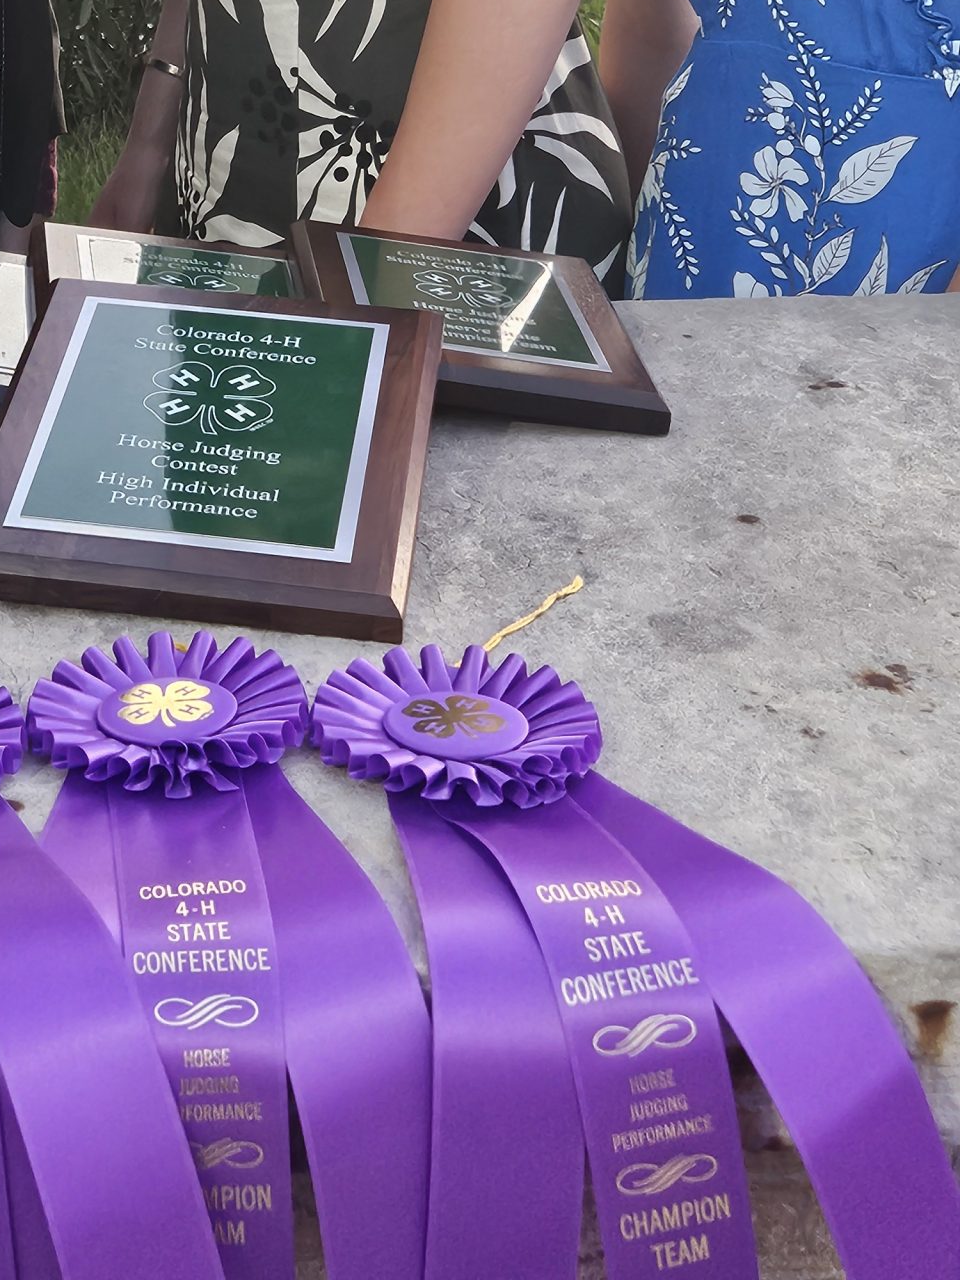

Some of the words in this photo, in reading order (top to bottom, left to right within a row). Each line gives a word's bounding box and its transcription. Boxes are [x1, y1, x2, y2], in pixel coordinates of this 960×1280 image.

[386, 255, 427, 267] State
[431, 261, 524, 280] Conference
[396, 250, 472, 266] Colorado
[160, 274, 182, 284] H
[204, 280, 226, 288] H
[168, 262, 260, 279] Conference
[425, 273, 448, 283] H
[470, 279, 492, 288] H
[429, 287, 451, 296] H
[479, 293, 502, 304] H
[413, 300, 463, 314] Horse
[469, 307, 537, 325] Judg
[444, 312, 510, 327] Conte
[156, 324, 254, 344] Colorado
[259, 333, 302, 349] 4-H
[444, 323, 491, 335] serve
[134, 337, 187, 353] State
[193, 343, 317, 365] Conference
[169, 369, 200, 387] H
[228, 374, 260, 391] H
[159, 398, 190, 416] H
[224, 403, 256, 422] H
[117, 433, 185, 452] Horse
[190, 441, 282, 465] Judging
[151, 455, 239, 476] Contest
[96, 471, 153, 490] High
[162, 477, 280, 503] Individual
[109, 490, 258, 519] Performance
[131, 689, 152, 699] H
[174, 686, 197, 696] H
[128, 708, 150, 719] H
[178, 704, 200, 715] H
[139, 879, 247, 900] COLORADO
[536, 880, 642, 903] COLORADO
[176, 900, 216, 917] 4-H
[584, 905, 625, 928] 4-H
[166, 922, 231, 942] STATE
[584, 931, 651, 962] STATE
[133, 948, 271, 975] CONFERENCE
[560, 957, 700, 1007] CONFERENCE
[183, 1048, 231, 1068] HORSE
[179, 1075, 240, 1096] JUDGING
[628, 1068, 677, 1095] HORSE
[181, 1102, 263, 1121] FORMANCE
[630, 1094, 689, 1122] JUDGING
[612, 1114, 713, 1153] PERFORMANCE
[204, 1184, 273, 1211] MPION
[620, 1193, 732, 1240] CHAMPION
[213, 1220, 245, 1245] AM
[650, 1233, 710, 1271] TEAM
